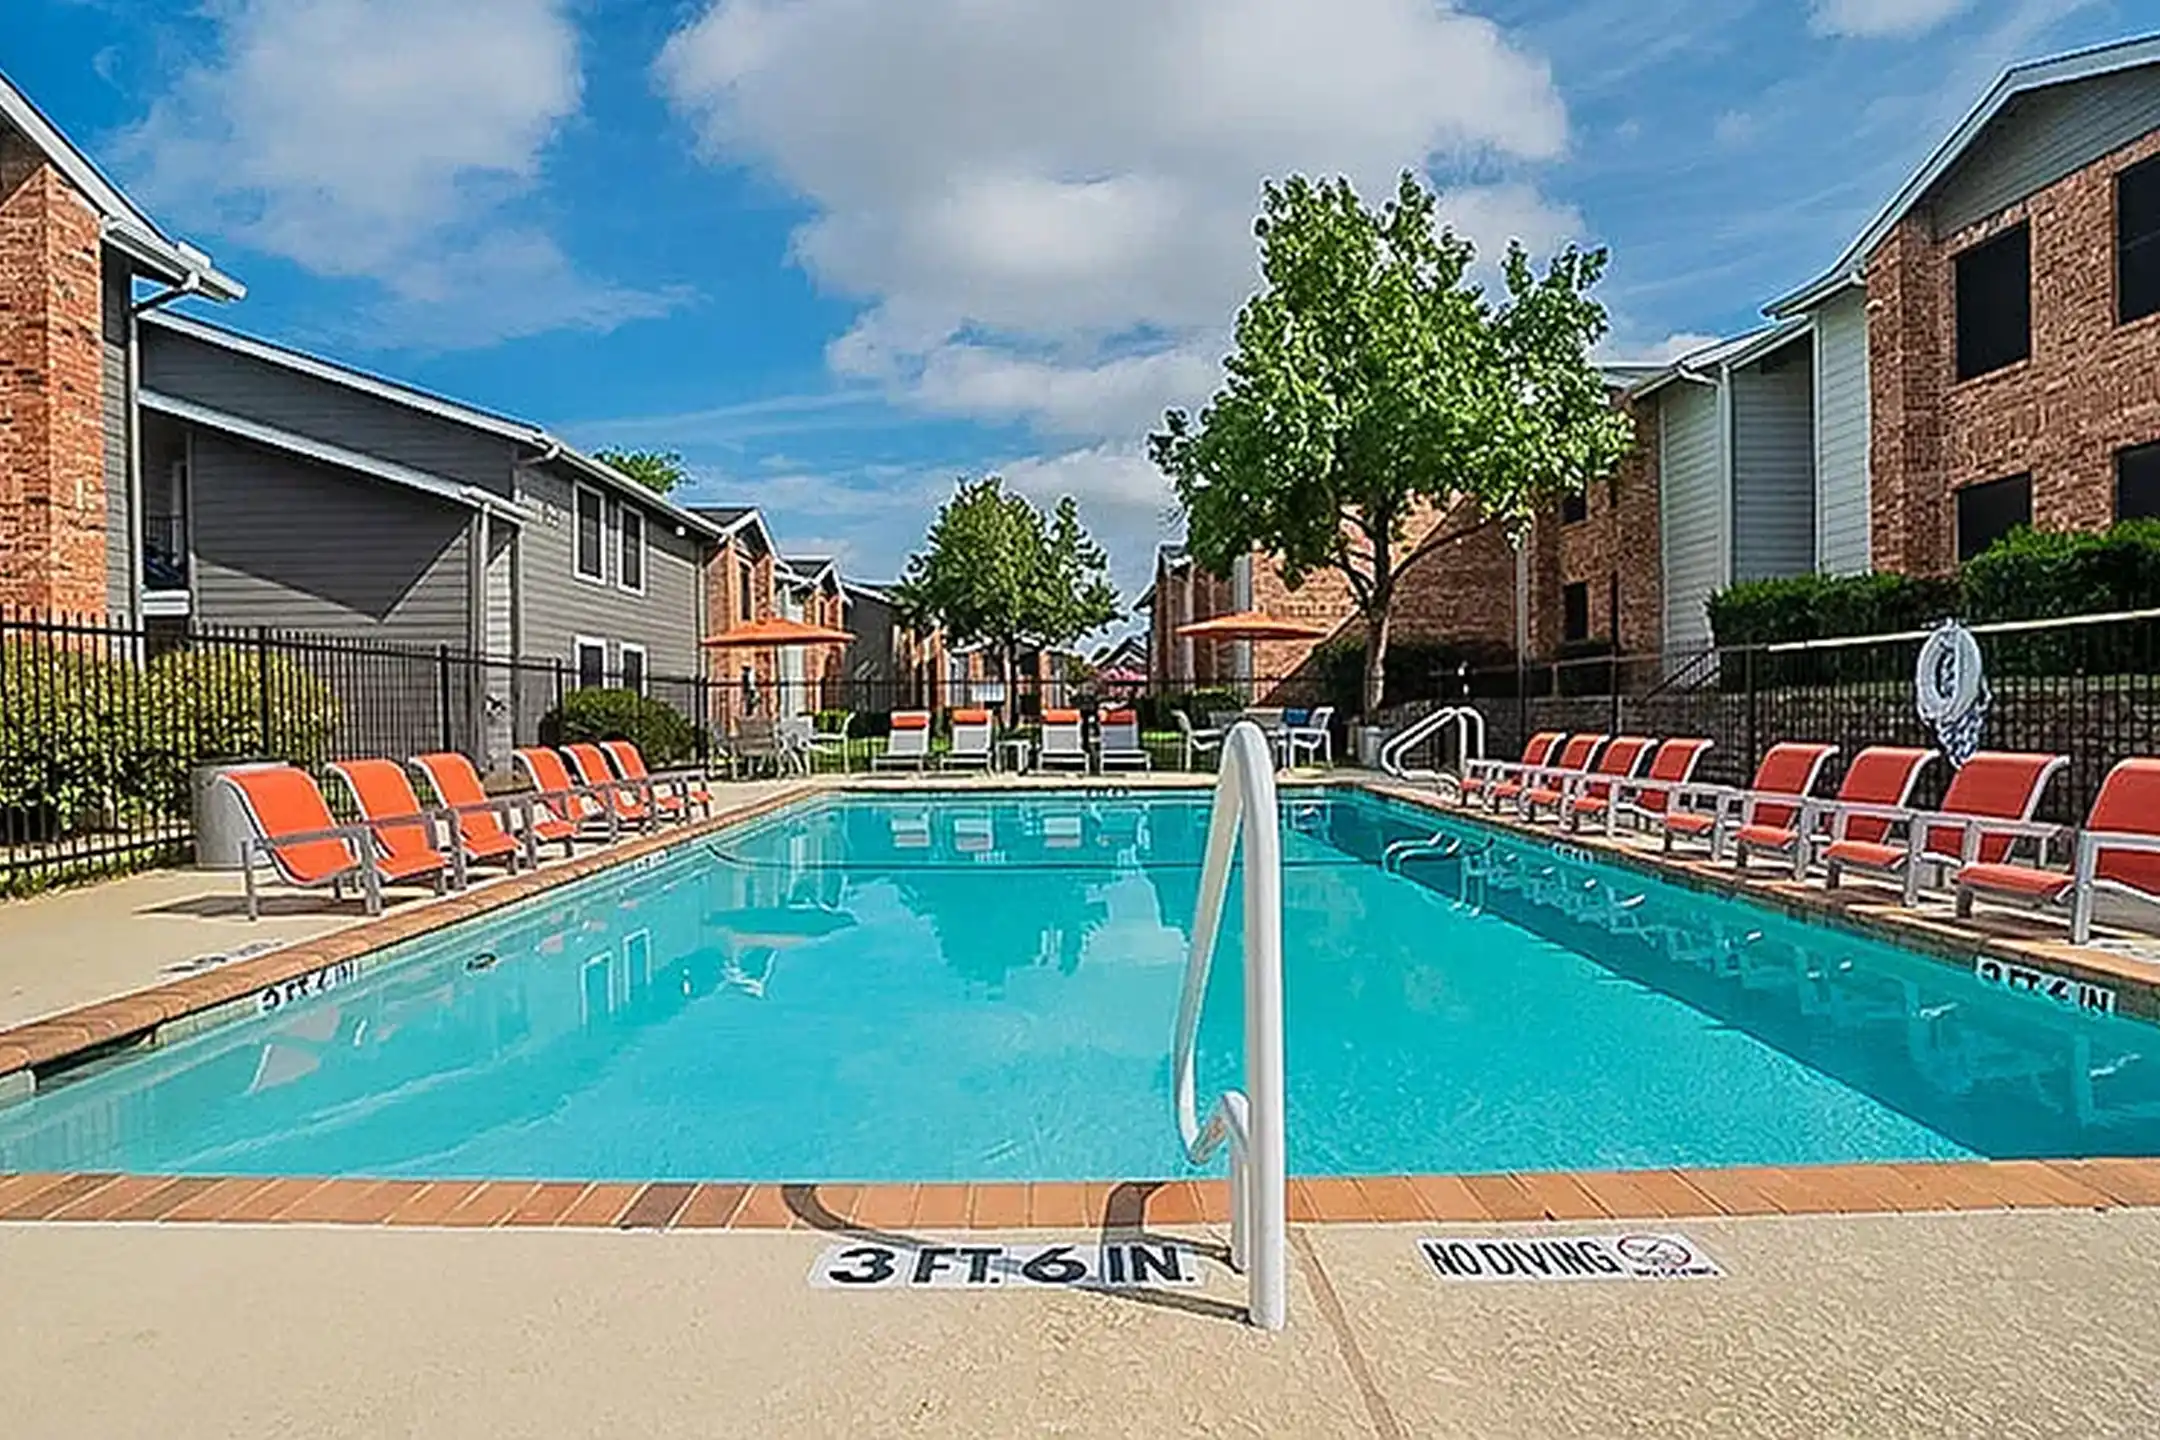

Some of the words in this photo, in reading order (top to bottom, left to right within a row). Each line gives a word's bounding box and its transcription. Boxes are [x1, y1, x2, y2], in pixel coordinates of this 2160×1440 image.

[829, 1248, 896, 1283] 3
[912, 1248, 1002, 1284] FT.
[1022, 1246, 1088, 1283] 6
[1108, 1246, 1195, 1284] IN.
[1422, 1243, 1483, 1275] NO
[1476, 1241, 1623, 1275] DIVING
